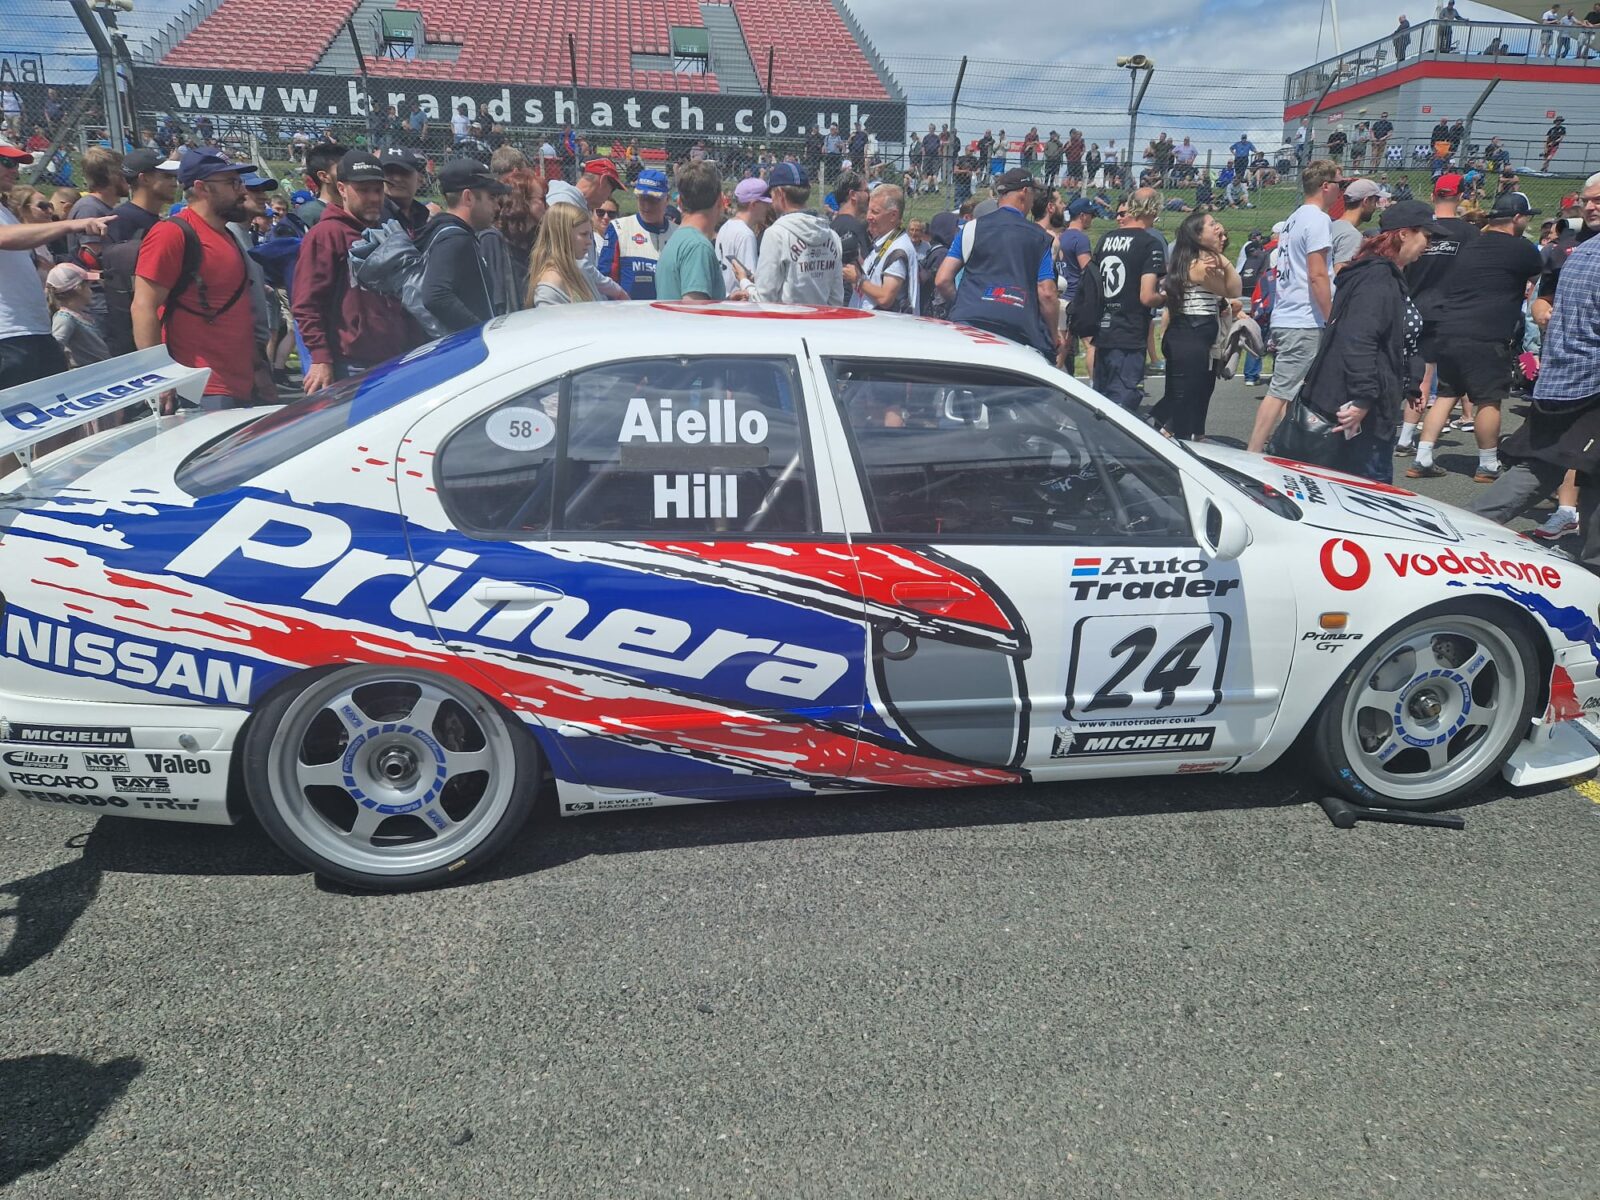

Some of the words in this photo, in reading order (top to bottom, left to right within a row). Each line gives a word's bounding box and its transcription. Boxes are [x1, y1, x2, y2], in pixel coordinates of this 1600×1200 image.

[1102, 236, 1134, 252] BLOCK
[509, 420, 532, 438] 58
[618, 398, 769, 444] Aiello
[654, 473, 738, 518] Hill
[1102, 557, 1209, 576] Auto
[1384, 548, 1562, 589] vodafone
[1069, 576, 1240, 601] Trader
[164, 496, 850, 700] Primera
[1301, 631, 1363, 643] Primera
[1316, 643, 1343, 653] GT
[6, 613, 253, 705] NISSAN
[1081, 622, 1215, 713] 24
[21, 728, 129, 744] MICHELIN
[1083, 733, 1210, 751] MICHELIN
[3, 751, 69, 768] Eibach
[85, 754, 127, 767] NGK
[145, 754, 212, 774] Valeo
[9, 771, 98, 789] RECARO
[112, 776, 170, 788] RAYS
[18, 789, 129, 808] FERODO
[136, 797, 200, 810] TRW
